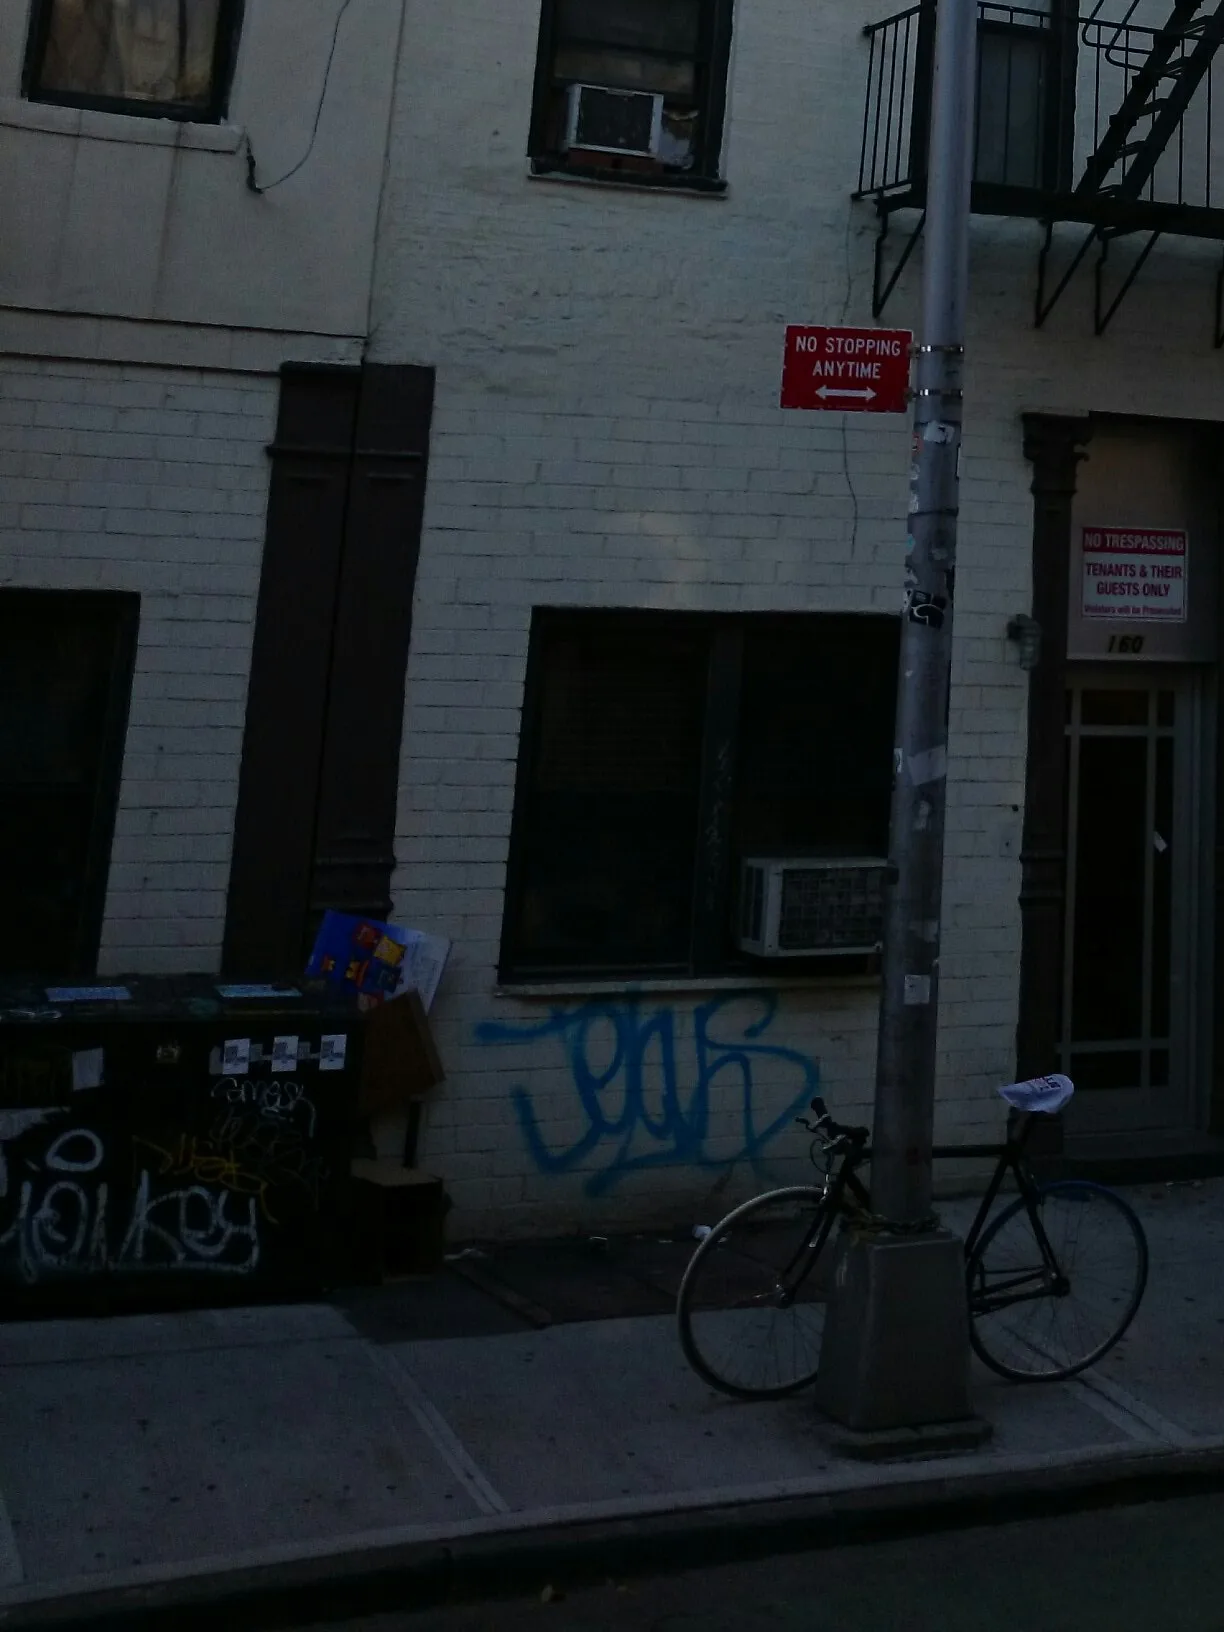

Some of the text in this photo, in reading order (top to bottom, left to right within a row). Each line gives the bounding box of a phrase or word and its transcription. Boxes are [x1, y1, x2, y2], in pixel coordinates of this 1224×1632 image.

[795, 335, 901, 357] NO STOPPING
[812, 360, 882, 379] ANYTIME
[1084, 531, 1185, 552] NO TRESPASSING
[1086, 562, 1182, 579] TENANTS & THEIR
[1096, 581, 1171, 597] GUESTS ONLY
[1108, 634, 1145, 653] 160
